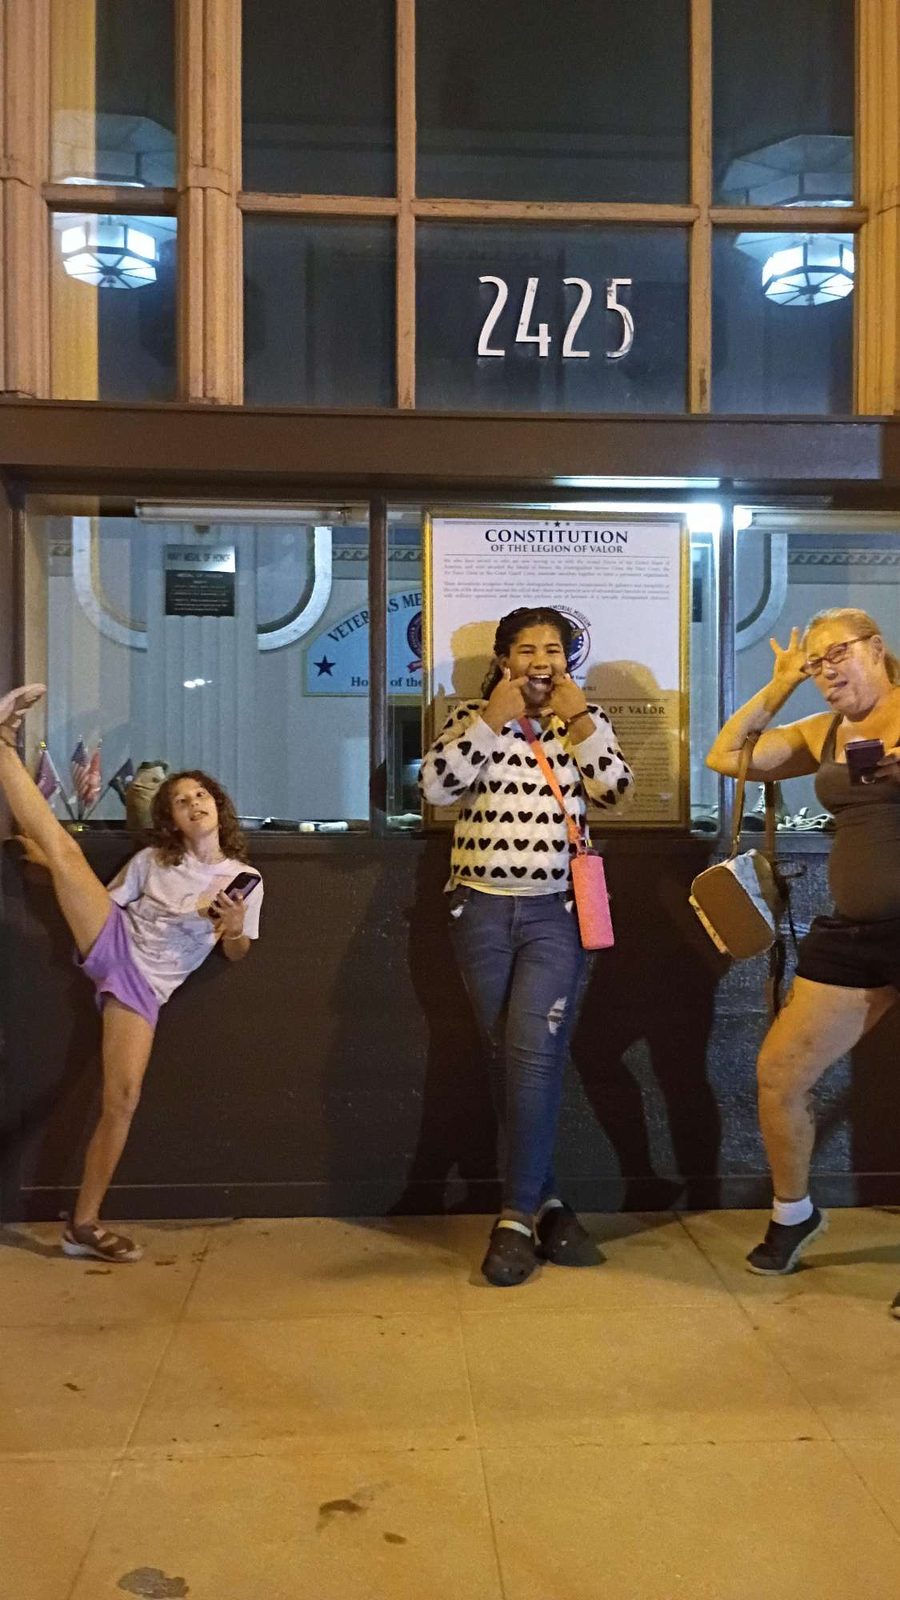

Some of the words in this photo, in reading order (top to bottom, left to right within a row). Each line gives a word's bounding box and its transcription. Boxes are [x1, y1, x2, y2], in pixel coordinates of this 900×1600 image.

[478, 275, 635, 358] 2425
[485, 529, 628, 543] CONSTITUTION
[490, 544, 505, 552] OF
[508, 544, 528, 552] THE
[531, 545, 571, 553] LEGION
[574, 545, 588, 553] OF
[590, 545, 624, 553] VALOR
[327, 598, 399, 642] VETERS
[351, 676, 369, 687] Ho
[390, 677, 404, 687] of
[608, 706, 624, 714] OF
[628, 706, 665, 714] VALOR
